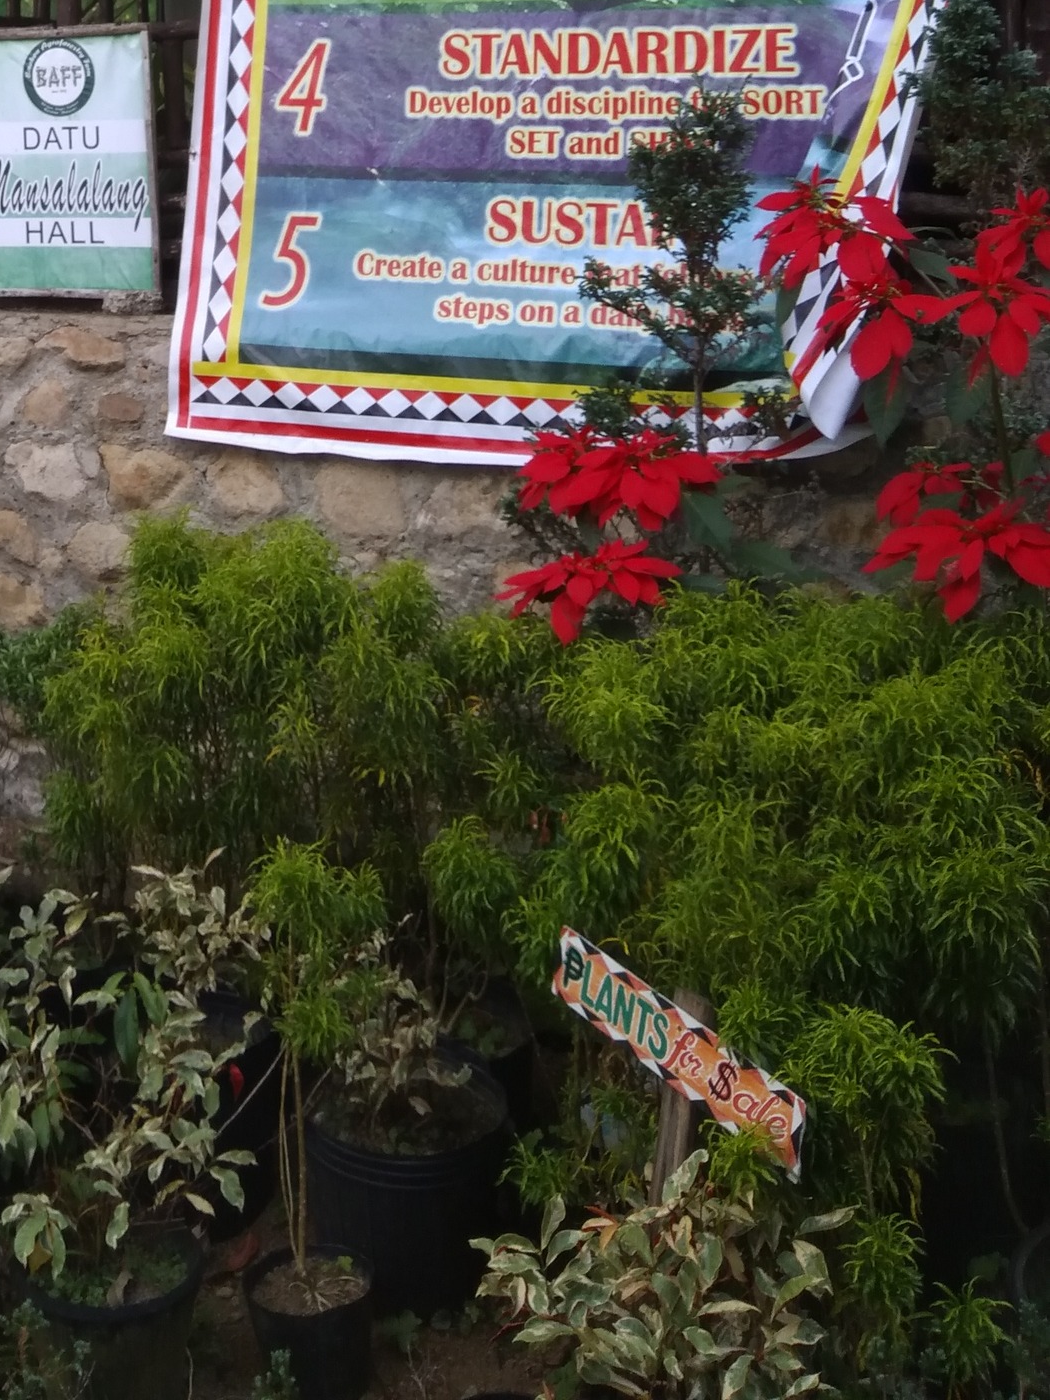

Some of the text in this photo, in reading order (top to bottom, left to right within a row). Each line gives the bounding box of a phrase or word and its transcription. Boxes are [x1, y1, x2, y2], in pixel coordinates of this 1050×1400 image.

[442, 27, 797, 76] STANDARDIZE
[35, 65, 83, 89] BAFF
[277, 42, 329, 133] 4
[408, 90, 512, 119] Develop
[521, 97, 538, 115] a
[547, 89, 680, 120] discipline
[742, 88, 824, 116] SORT
[23, 126, 100, 151] DATU
[509, 129, 561, 155] SET
[568, 130, 620, 156] and
[25, 220, 105, 244] HALL
[487, 199, 676, 247] SUSTA
[261, 215, 320, 306] 5
[356, 251, 443, 278] Create
[450, 263, 468, 280] a
[476, 258, 576, 285] culture
[437, 296, 510, 325] steps
[519, 303, 554, 323] on
[562, 303, 581, 324] a
[663, 1031, 703, 1078] for
